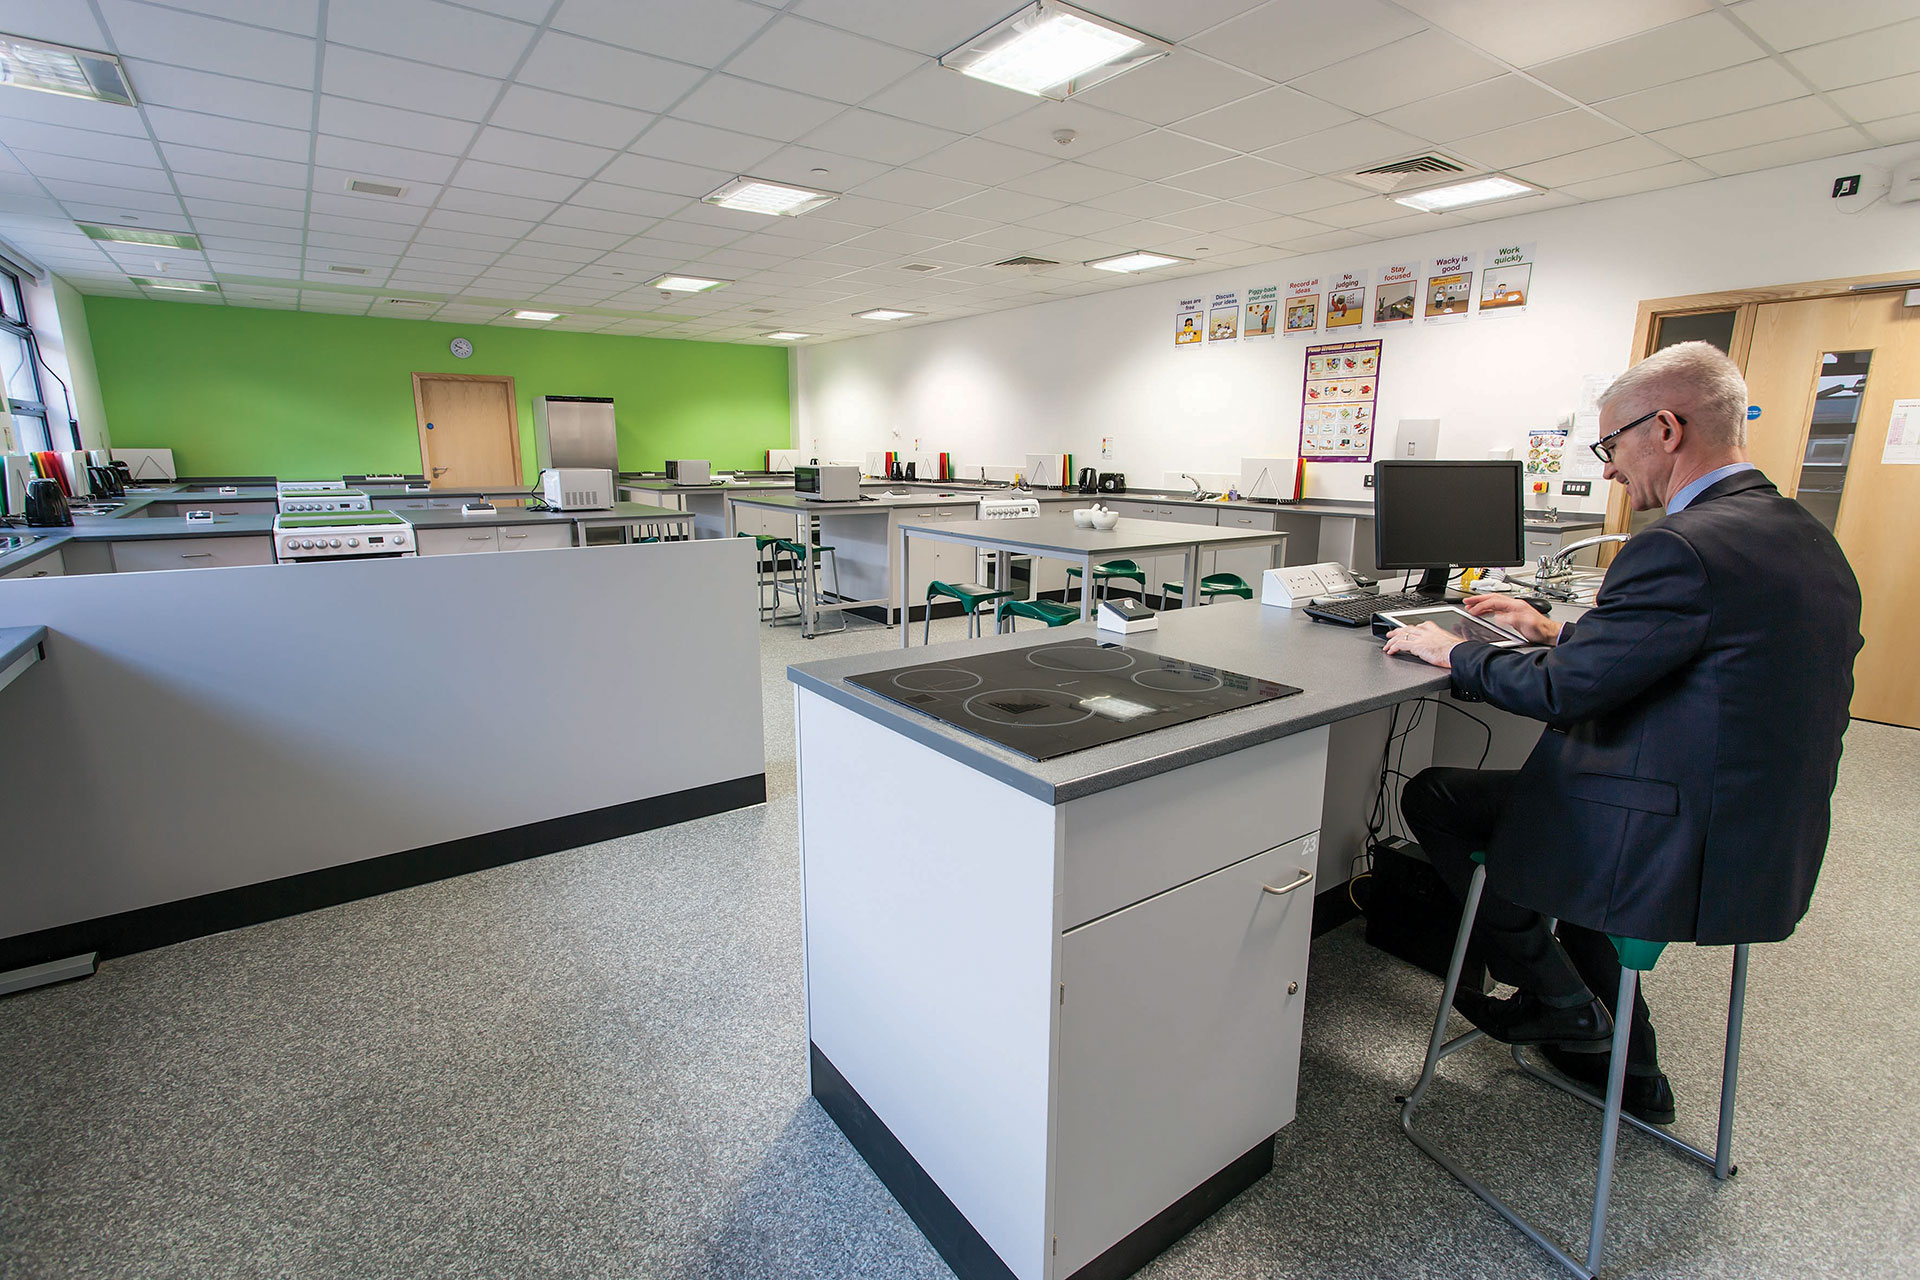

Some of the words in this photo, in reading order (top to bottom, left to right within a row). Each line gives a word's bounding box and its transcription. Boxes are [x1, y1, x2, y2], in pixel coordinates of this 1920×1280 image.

[1499, 246, 1520, 255] Work
[1436, 257, 1460, 266] Wacky
[1494, 254, 1524, 265] quickly
[1441, 264, 1461, 274] good
[1384, 272, 1411, 282] focused
[1289, 281, 1310, 289] Record
[1335, 280, 1359, 290] judging
[1301, 837, 1317, 856] 23
